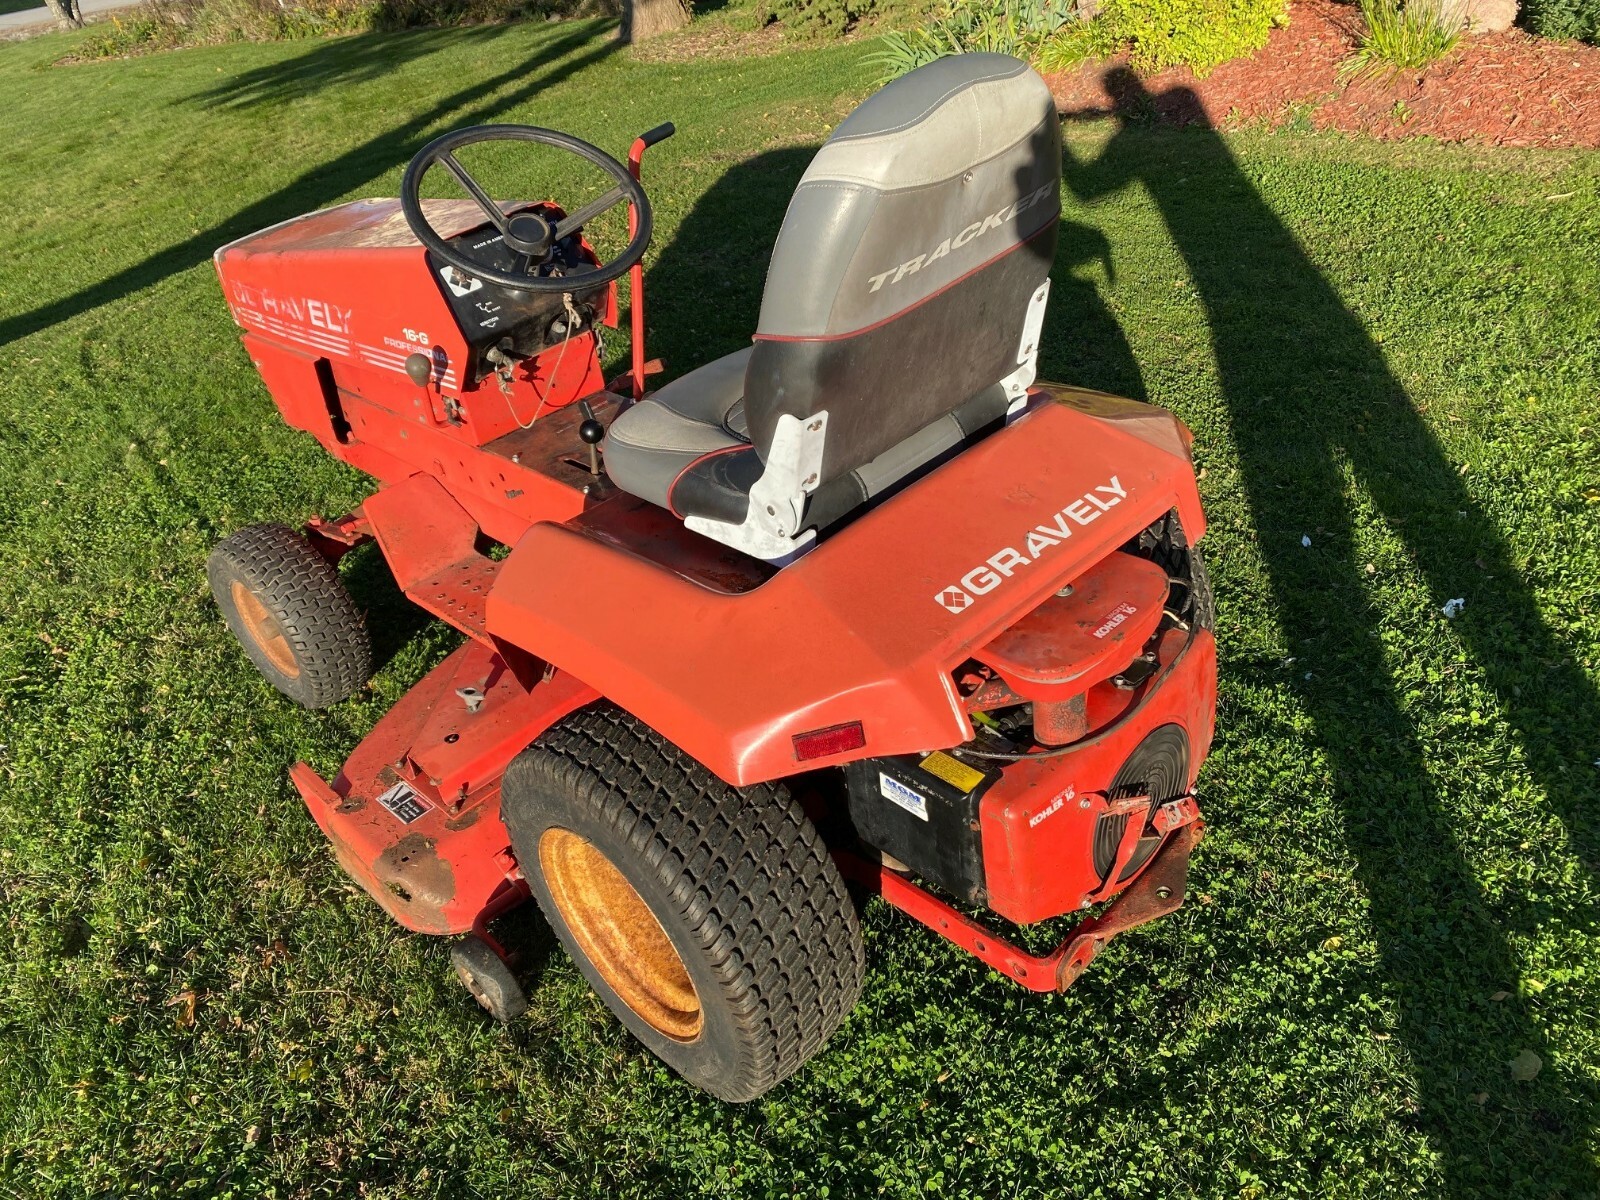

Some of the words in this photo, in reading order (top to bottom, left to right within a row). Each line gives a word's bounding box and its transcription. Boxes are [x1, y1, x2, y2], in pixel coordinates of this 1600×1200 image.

[868, 178, 1056, 294] TRACKER
[402, 328, 429, 345] 16-G
[961, 475, 1127, 595] GRAVELY
[1093, 613, 1128, 639] KOHLER
[1121, 606, 1137, 614] 16
[1029, 798, 1064, 828] KOHLER
[1064, 791, 1075, 802] 16
